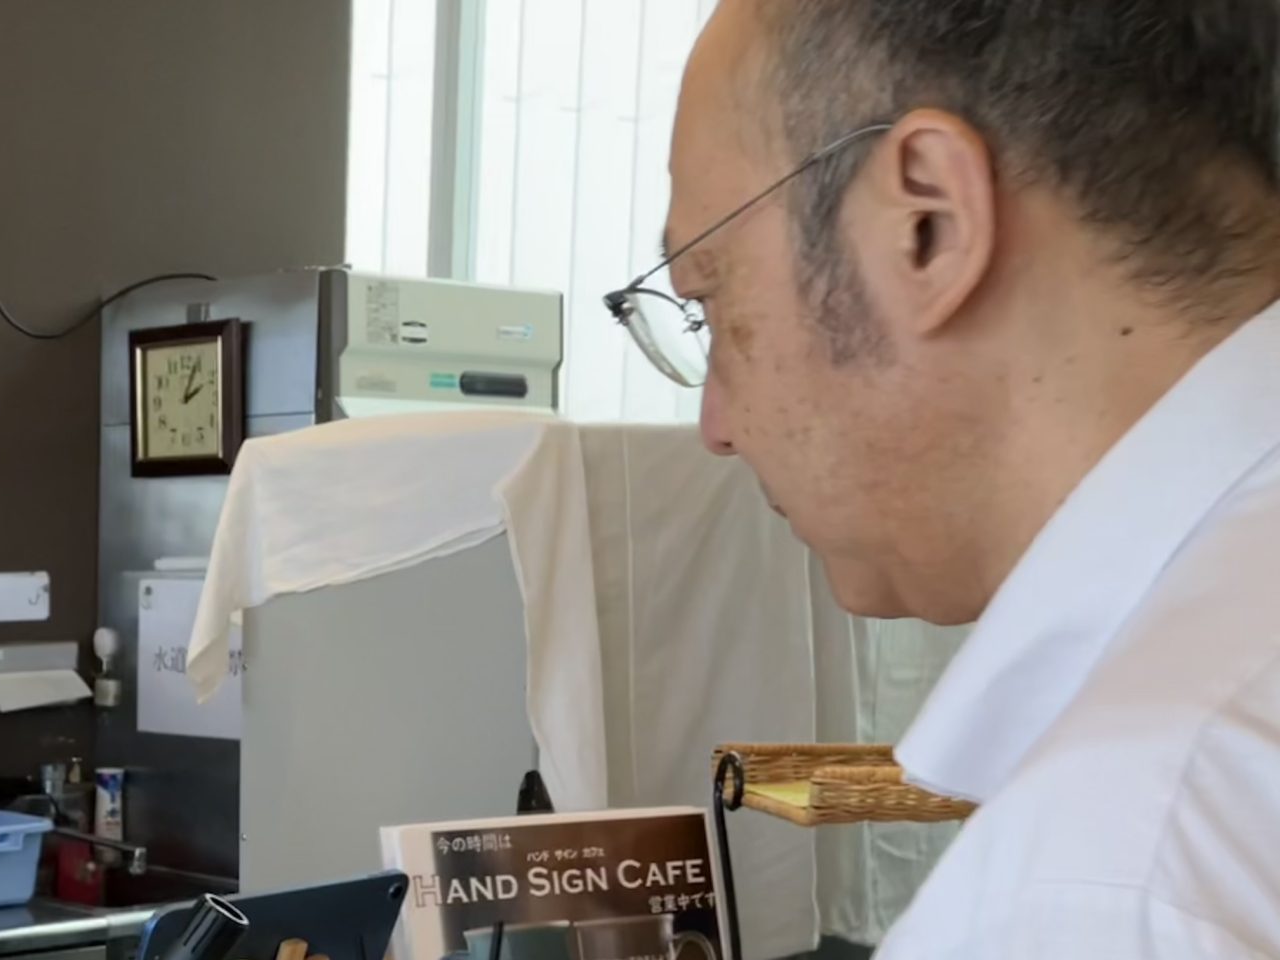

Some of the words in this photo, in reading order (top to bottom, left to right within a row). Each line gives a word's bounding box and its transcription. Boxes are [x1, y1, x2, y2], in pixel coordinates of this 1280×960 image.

[436, 834, 513, 855] 今の時間は
[414, 873, 519, 907] HAND
[527, 866, 609, 897] SIGN
[617, 858, 706, 889] CAFE
